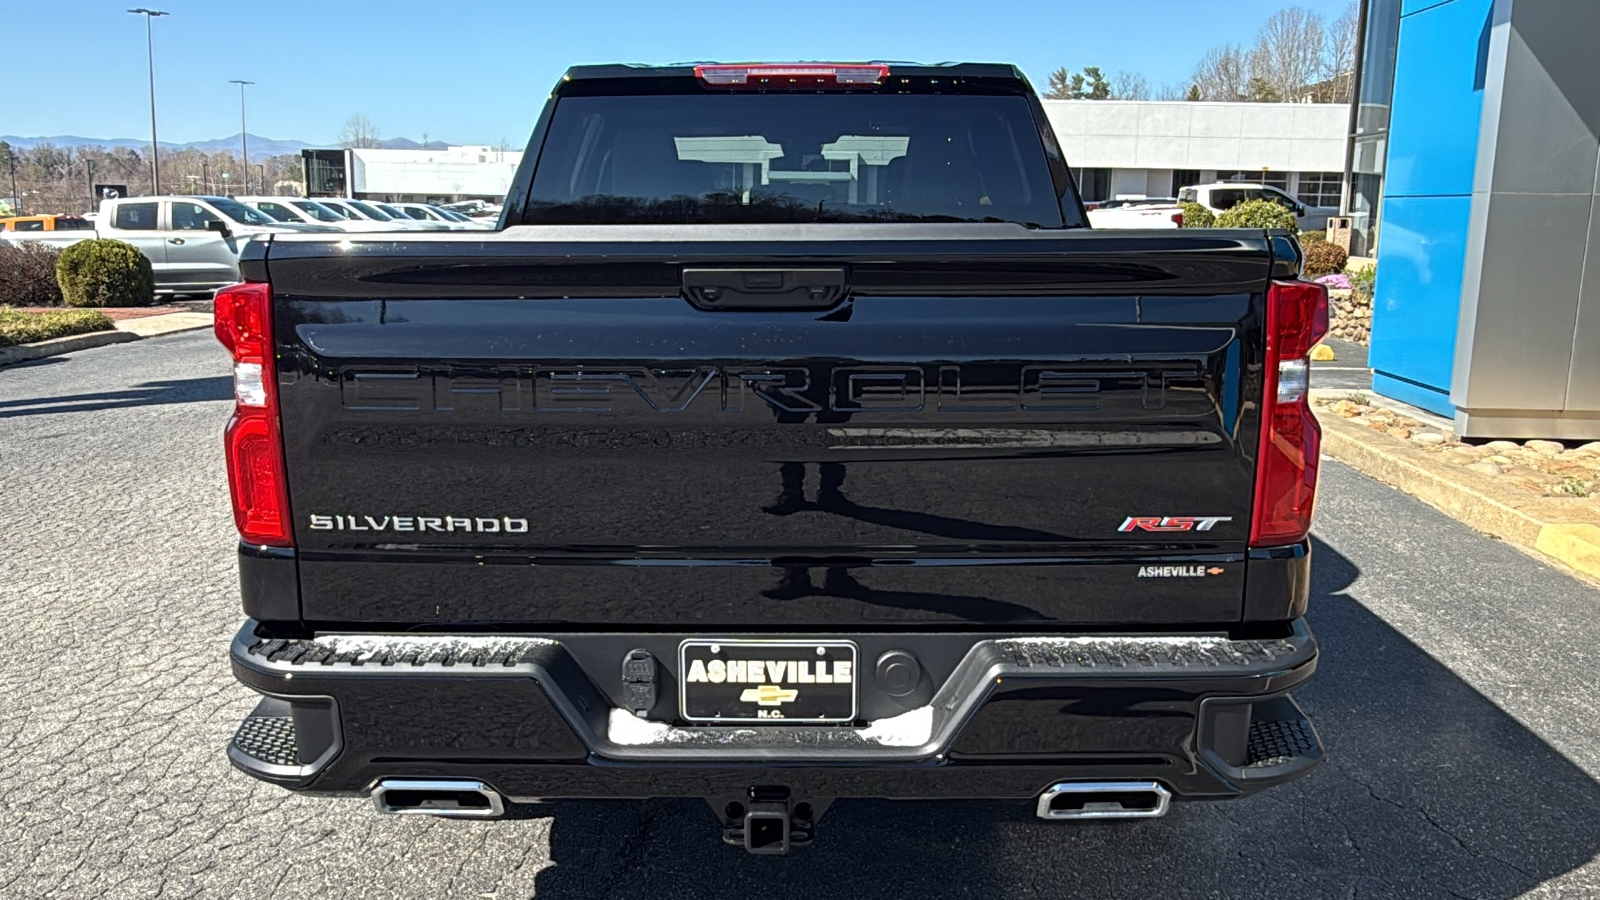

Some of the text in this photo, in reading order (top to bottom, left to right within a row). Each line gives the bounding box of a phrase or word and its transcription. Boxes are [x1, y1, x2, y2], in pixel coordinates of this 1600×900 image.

[341, 365, 1198, 413] CHEVROLET
[309, 513, 529, 534] SILVERADO
[1117, 516, 1233, 532] RST
[1137, 565, 1206, 578] ASHEVILLE
[686, 659, 852, 684] ASHEVILLE
[757, 709, 785, 719] N.C.
